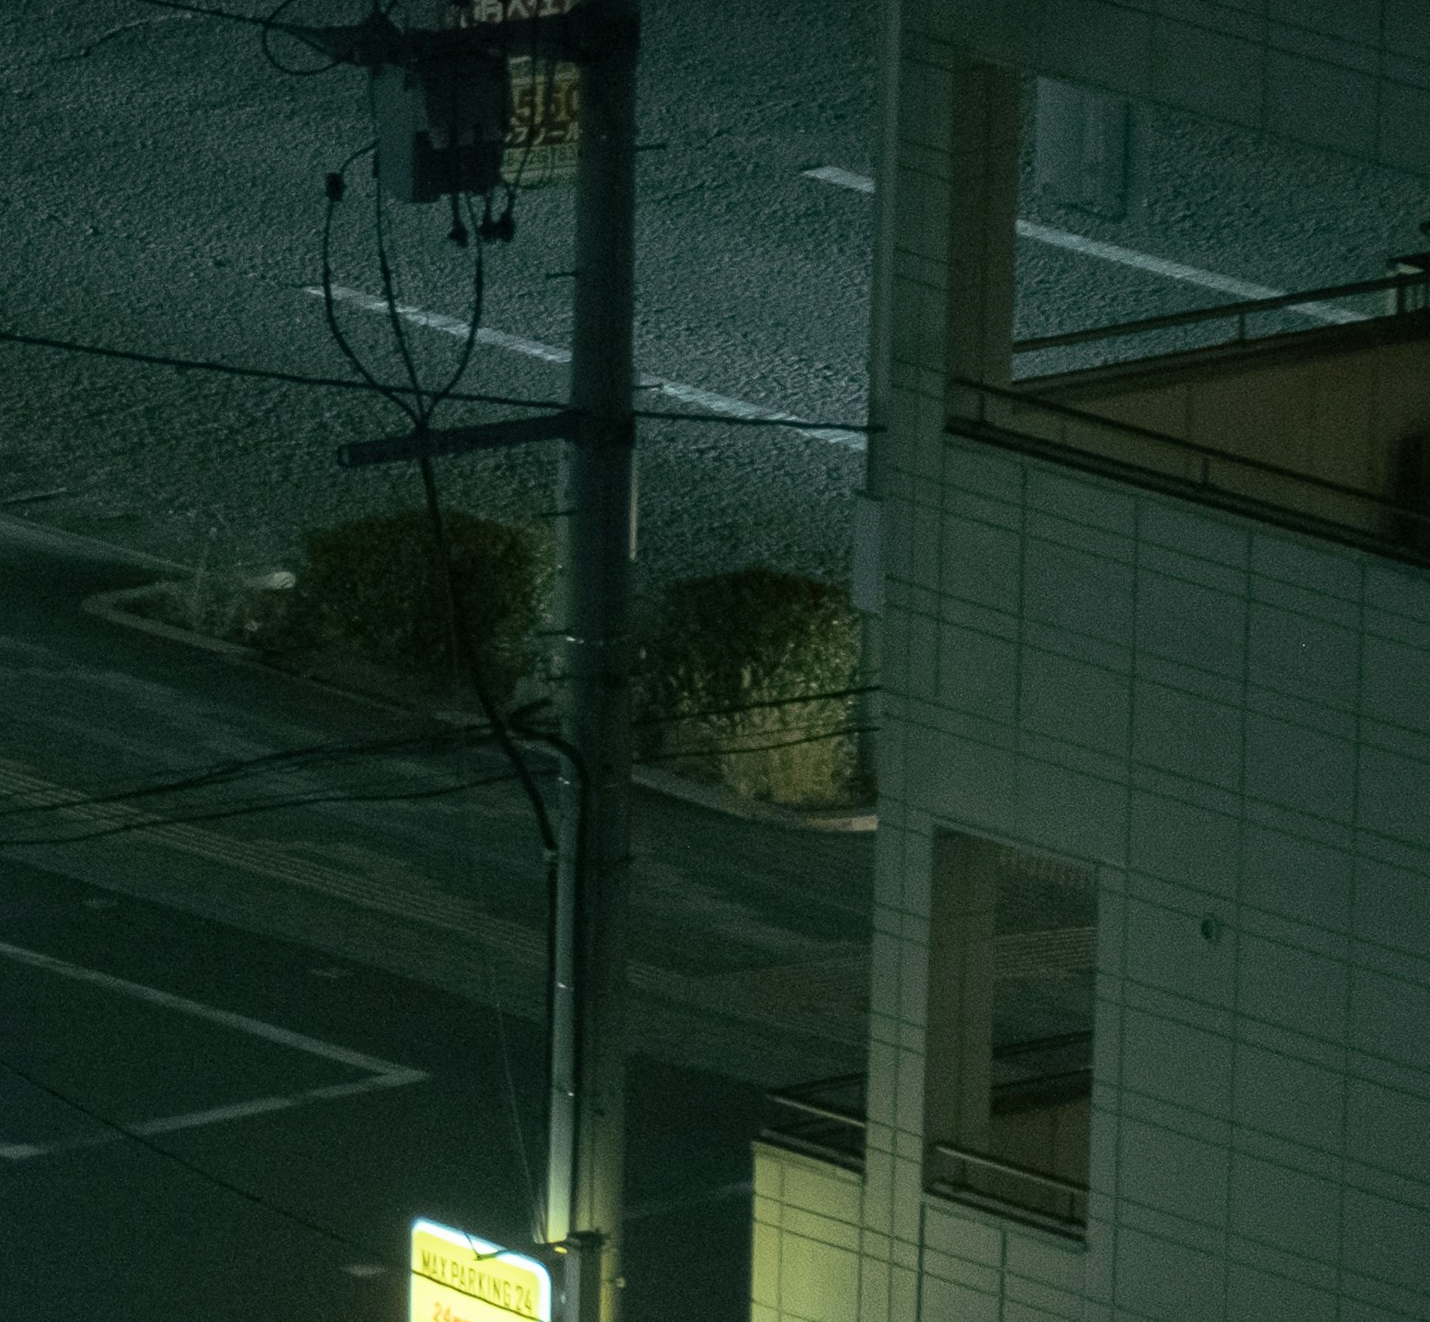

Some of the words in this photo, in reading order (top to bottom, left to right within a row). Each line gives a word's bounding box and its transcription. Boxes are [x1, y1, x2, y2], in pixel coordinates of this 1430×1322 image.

[420, 1247, 448, 1282] MAX
[449, 1261, 512, 1311] PARKING
[515, 1283, 535, 1314] 24
